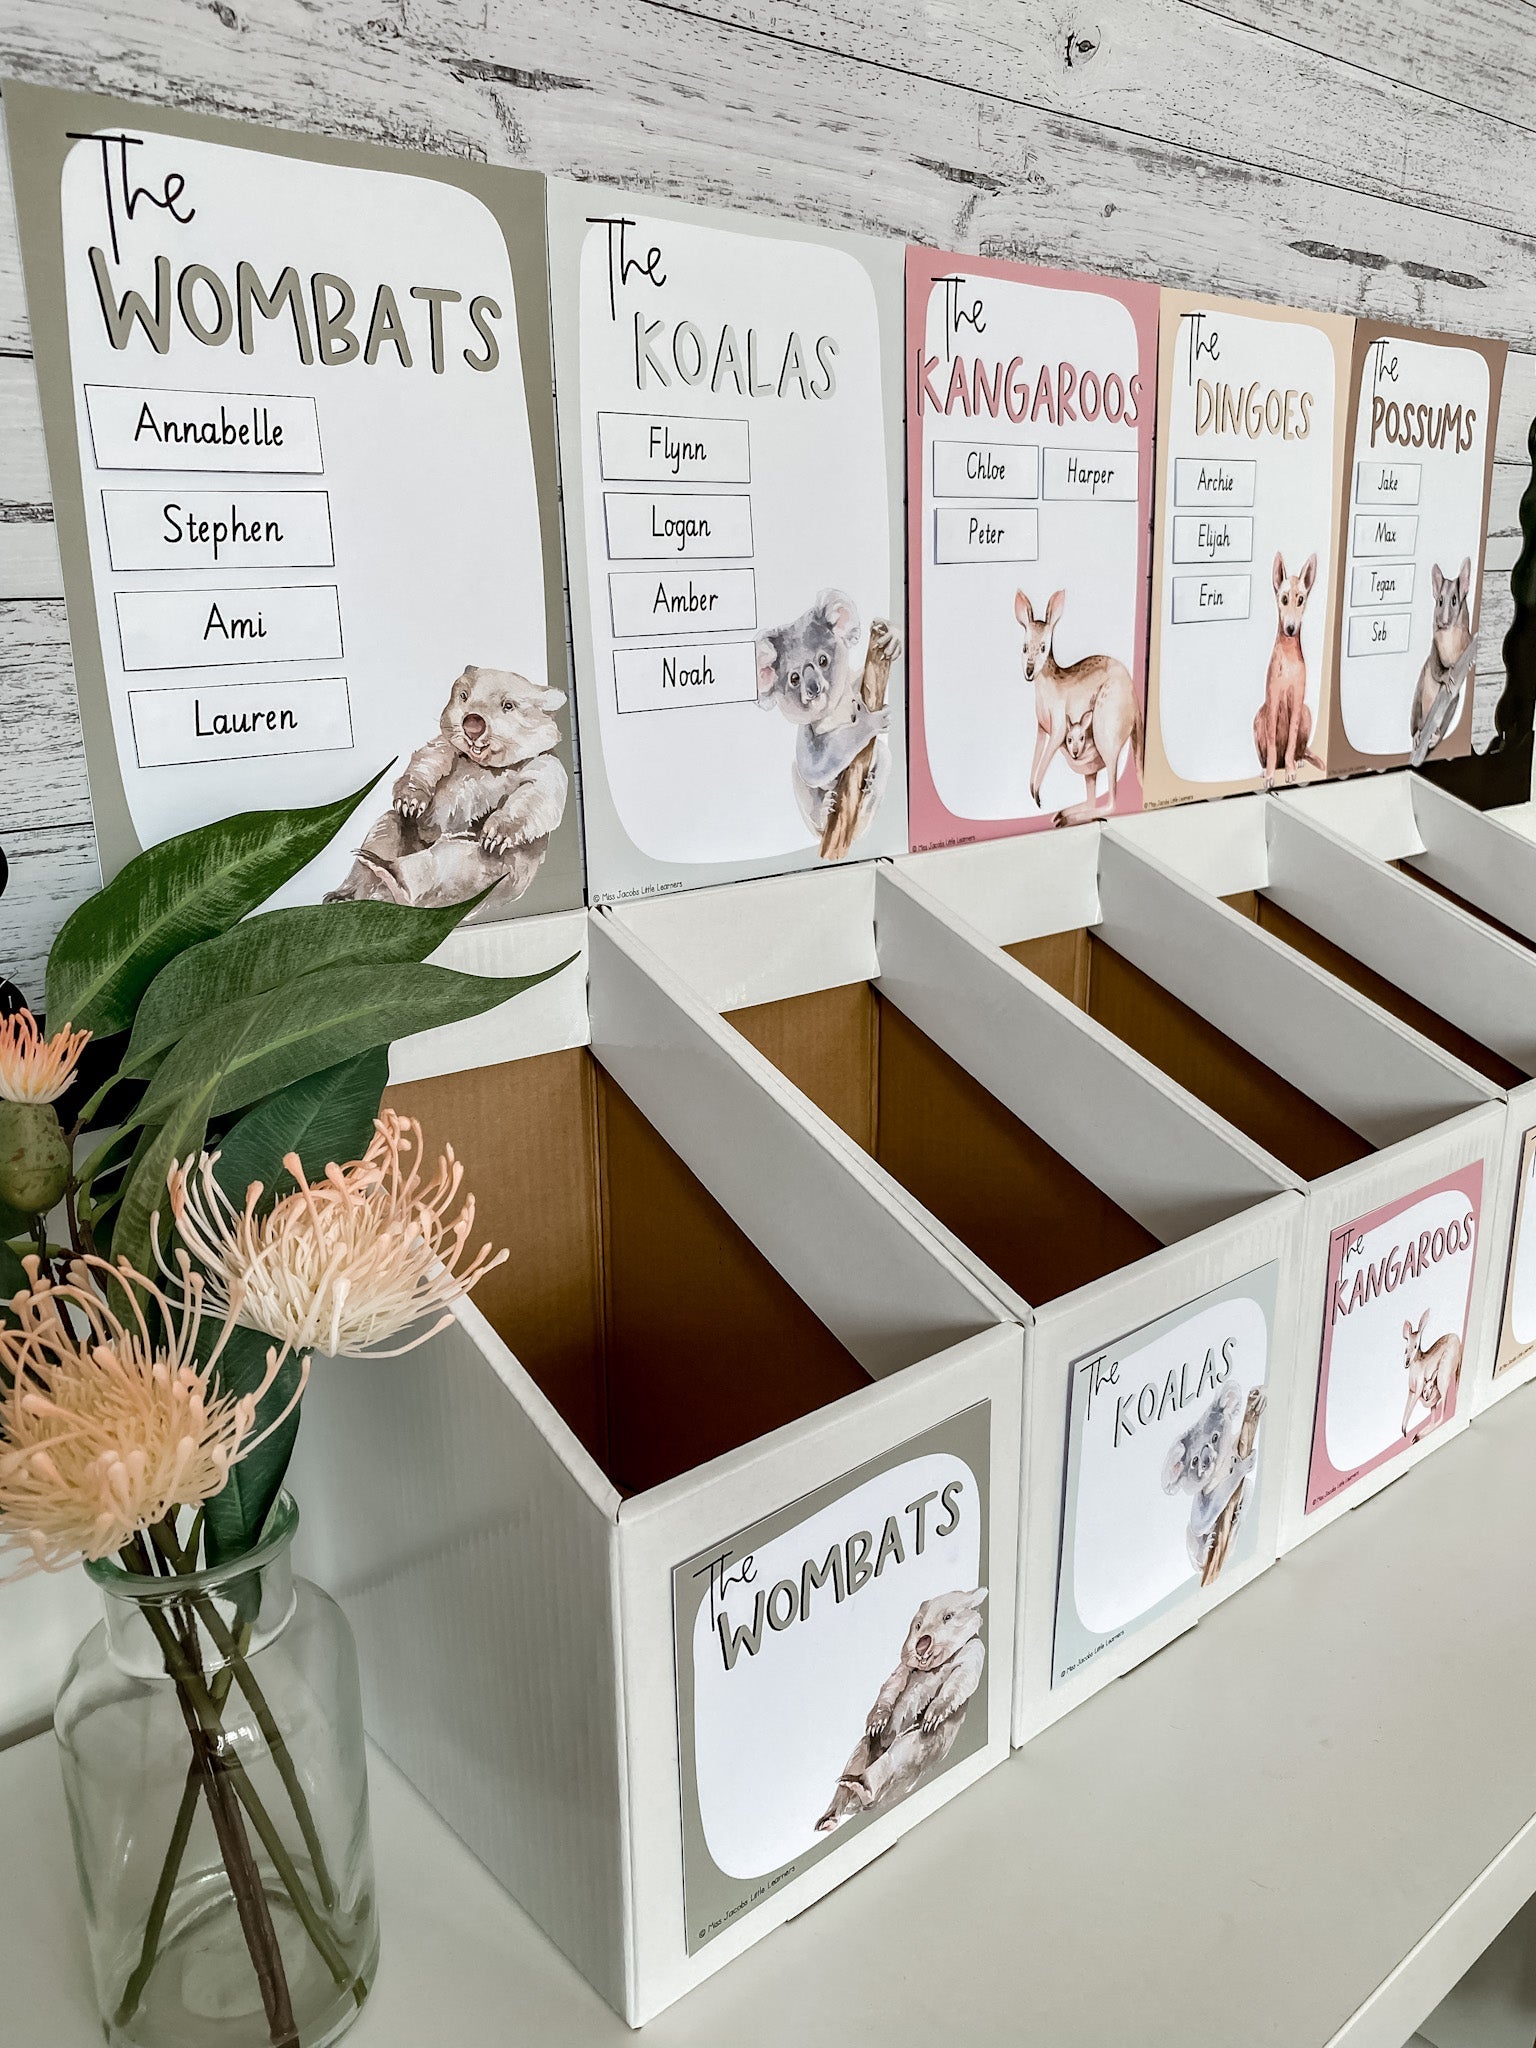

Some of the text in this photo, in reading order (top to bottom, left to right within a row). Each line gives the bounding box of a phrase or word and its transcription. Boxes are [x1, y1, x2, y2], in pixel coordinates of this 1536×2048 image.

[66, 132, 195, 264] The
[585, 217, 667, 321] The
[88, 246, 502, 374] WOMBATS
[930, 276, 987, 363] The
[634, 311, 840, 401] KOALAS
[1180, 312, 1220, 386] The
[1369, 340, 1399, 396] The
[915, 348, 1145, 428] KANGAROOS
[1195, 378, 1315, 441] DINGOES
[134, 402, 284, 446] Annabelle
[648, 425, 707, 474] Flynn
[1370, 395, 1477, 453] POSSUMS
[966, 451, 1006, 480] Chloe
[1067, 457, 1115, 495] Harper
[1197, 467, 1234, 492] Archie
[1377, 468, 1398, 492] Jake
[163, 504, 284, 560] Stephen
[651, 504, 711, 552] Logan
[968, 517, 1005, 545] Peter
[1198, 523, 1231, 558] Elijah
[1375, 522, 1397, 543] Max
[652, 581, 719, 614] Amber
[1199, 583, 1224, 607] Erin
[1371, 571, 1396, 601] Tegan
[203, 602, 268, 640] Ami
[1372, 621, 1387, 641] Seb
[662, 654, 716, 690] Noah
[194, 699, 298, 738] Lauren
[616, 887, 640, 899] Jacobs
[656, 881, 683, 892] Learners
[1331, 1211, 1474, 1326] KANGAROOS
[1335, 1228, 1365, 1281] The
[1079, 1355, 1120, 1421] The
[1113, 1336, 1237, 1448] KOALAS
[693, 1550, 758, 1632] The
[717, 1480, 964, 1671] WOMBATS
[724, 1900, 748, 1920] Jacobs
[767, 1865, 796, 1889] Learners
